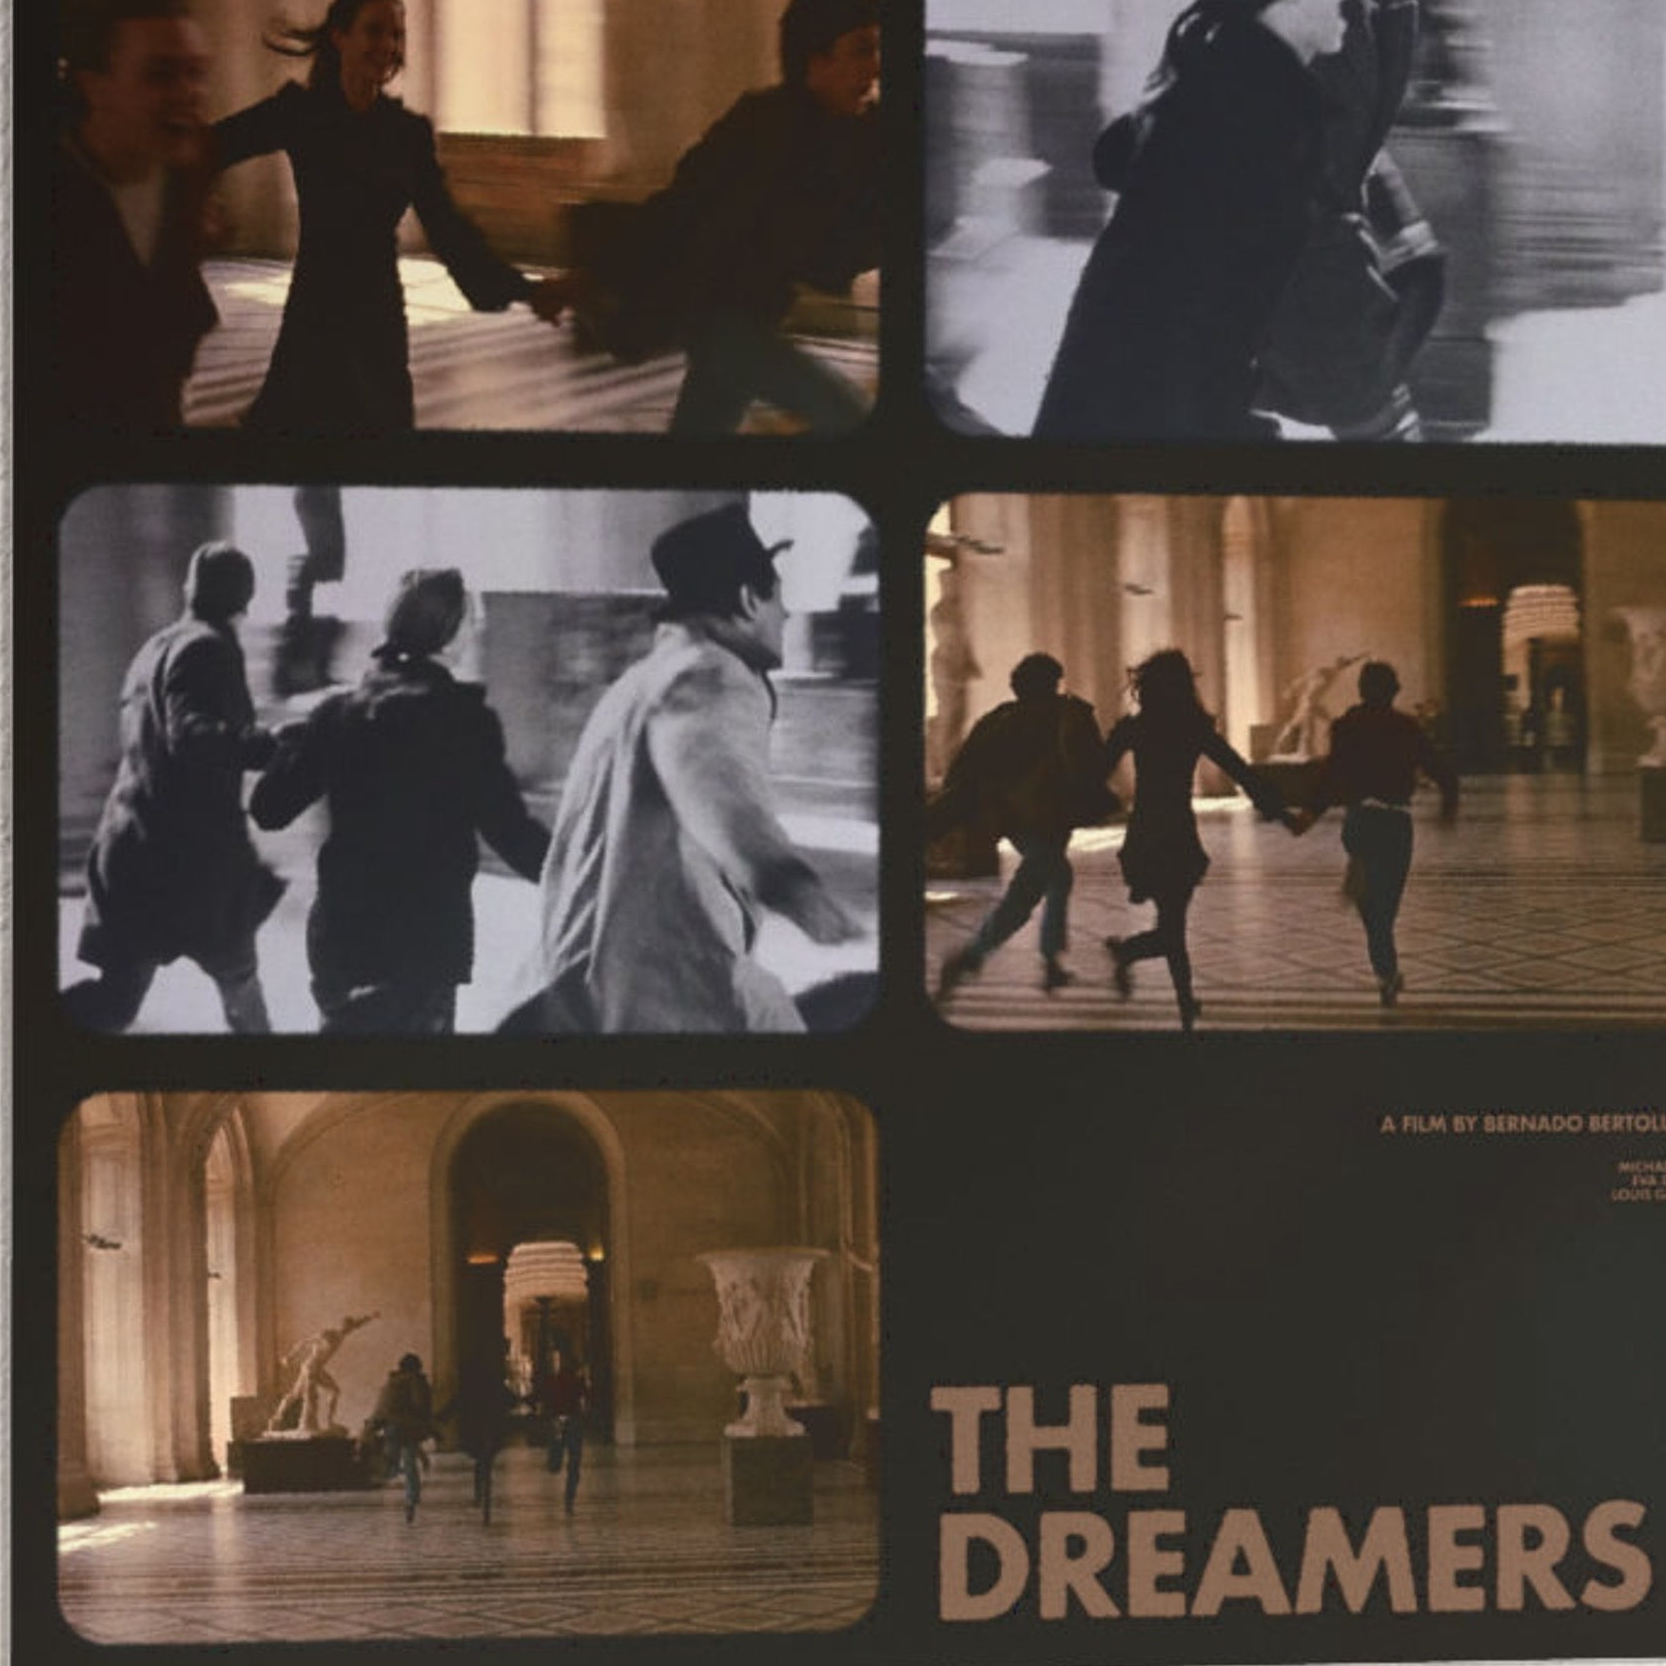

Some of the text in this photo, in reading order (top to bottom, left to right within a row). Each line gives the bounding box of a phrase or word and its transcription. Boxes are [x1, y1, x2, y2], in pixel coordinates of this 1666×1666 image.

[1381, 1116, 1396, 1133] A
[1401, 1115, 1447, 1133] FILM
[1453, 1115, 1478, 1133] BY
[1483, 1114, 1583, 1133] BERNADO
[930, 1384, 1170, 1495] THE
[940, 1500, 1653, 1622] DREAMERS
